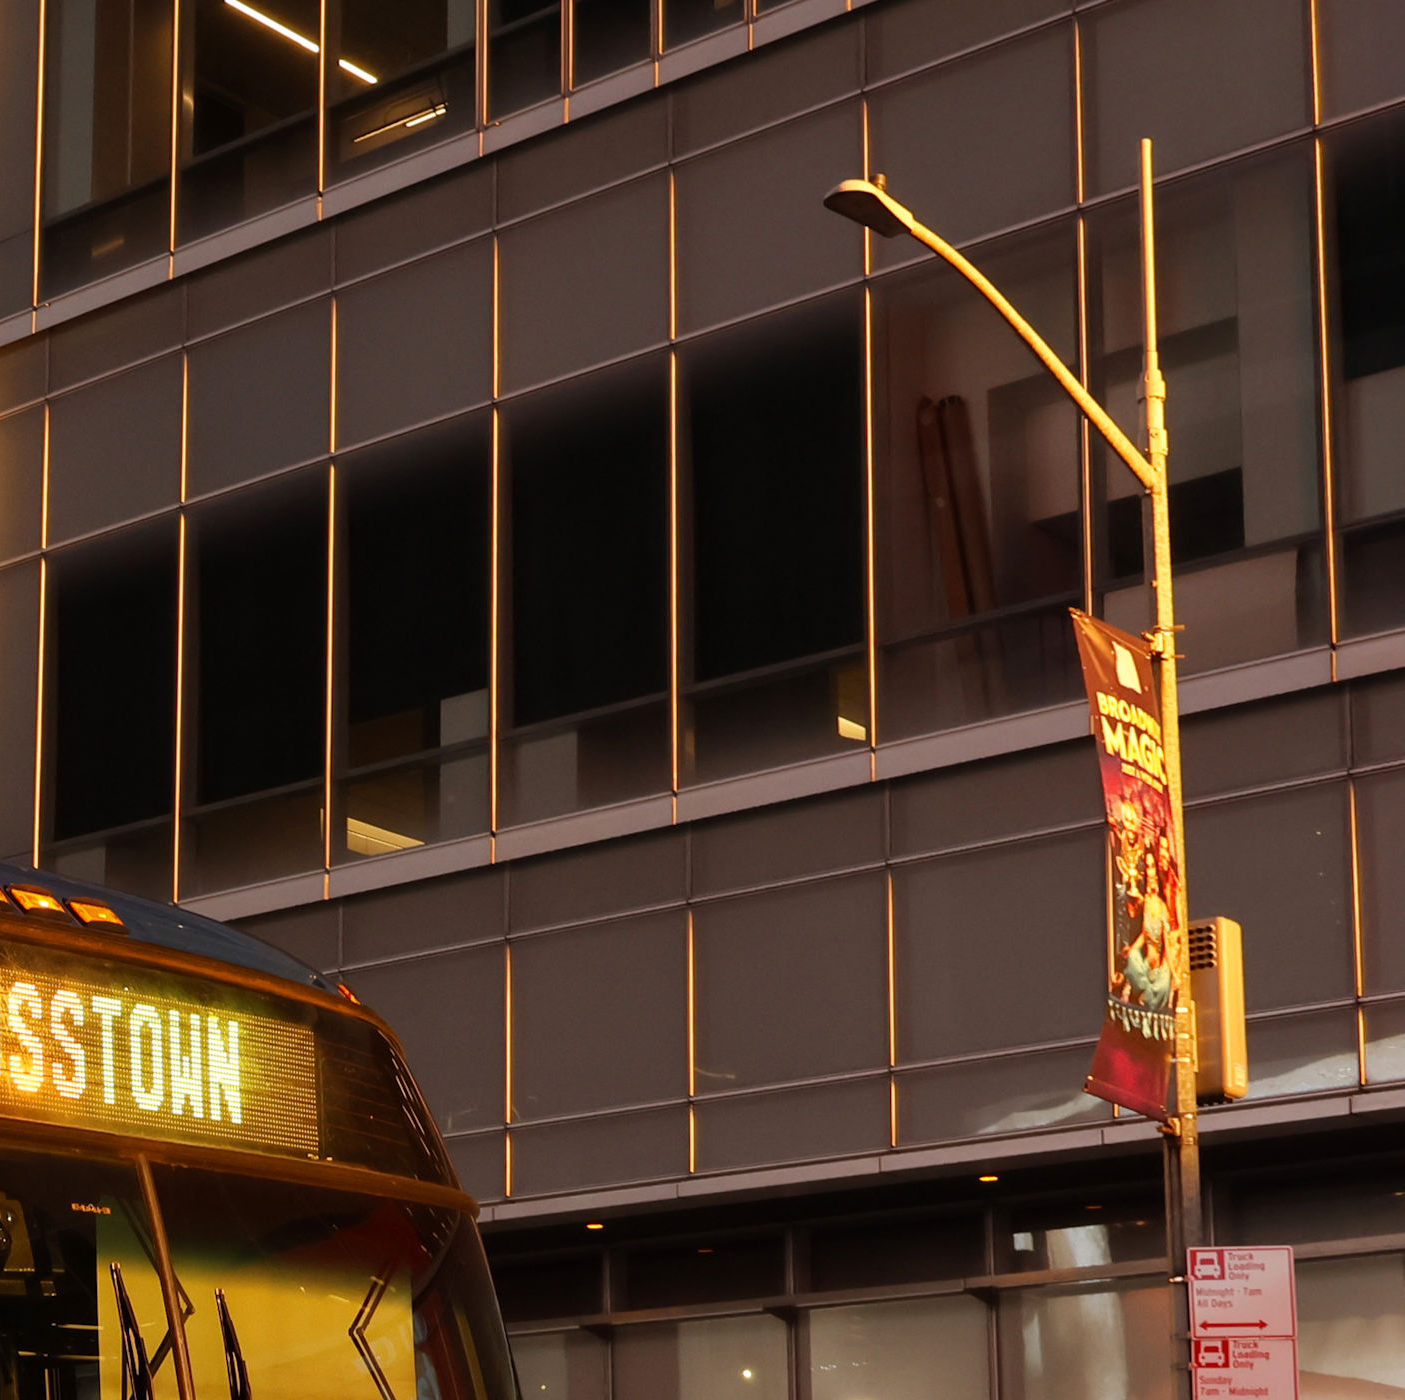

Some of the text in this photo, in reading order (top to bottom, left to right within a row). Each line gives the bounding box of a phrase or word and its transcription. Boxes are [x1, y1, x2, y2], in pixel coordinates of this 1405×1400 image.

[1101, 715, 1167, 785] MAGIC
[1227, 1252, 1254, 1261] Truck
[1228, 1262, 1265, 1273] Loading
[1228, 1272, 1249, 1282] Only
[1196, 1287, 1234, 1298] Midnight
[1197, 1298, 1233, 1309] All Days
[1232, 1340, 1259, 1349] Truck
[1233, 1350, 1270, 1361] Loading
[1233, 1360, 1254, 1370] Only
[1200, 1376, 1232, 1387] Sunday
[1229, 1386, 1269, 1398] Midnight
